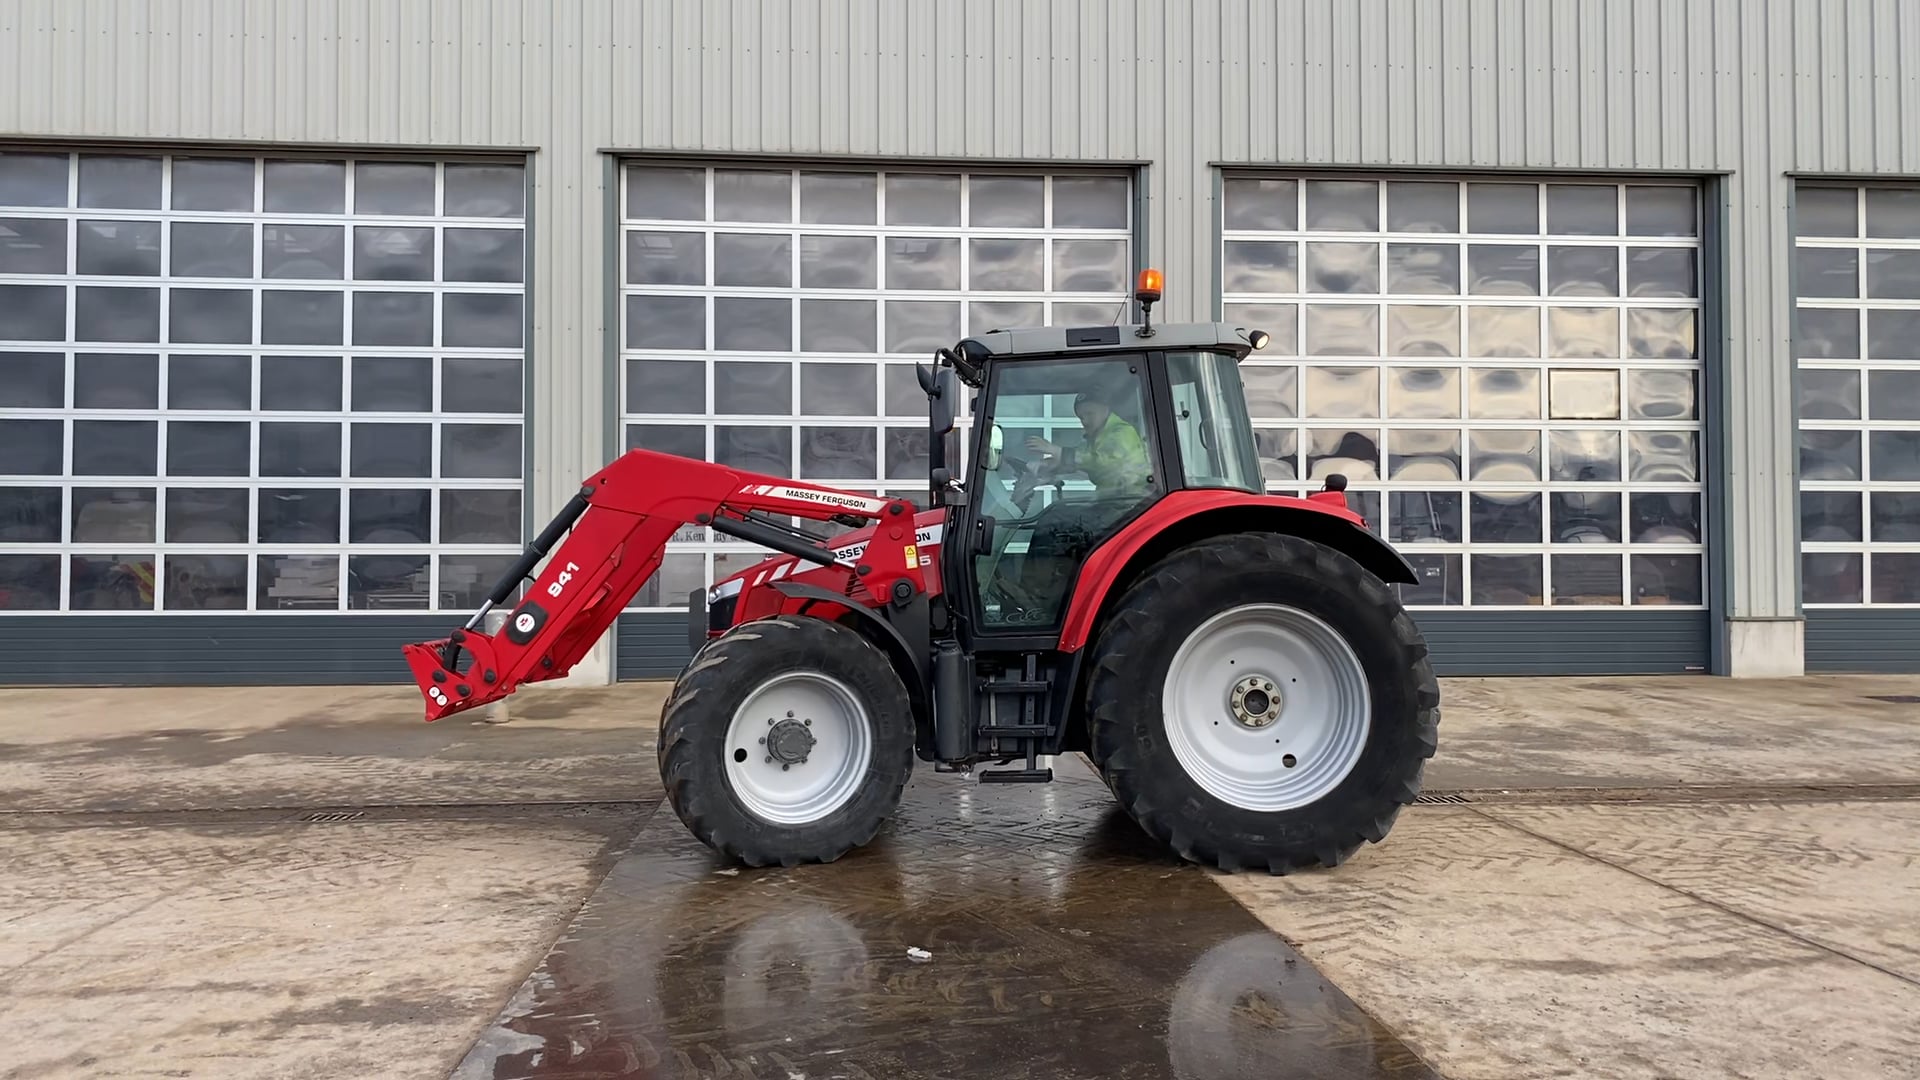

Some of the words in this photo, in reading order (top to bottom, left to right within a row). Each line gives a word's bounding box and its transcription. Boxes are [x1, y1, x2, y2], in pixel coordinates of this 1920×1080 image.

[785, 489, 821, 501] MASSEY
[821, 495, 867, 508] FERGUSON
[685, 530, 727, 543] Kendy
[833, 545, 866, 559] SSEY
[547, 562, 580, 597] 941
